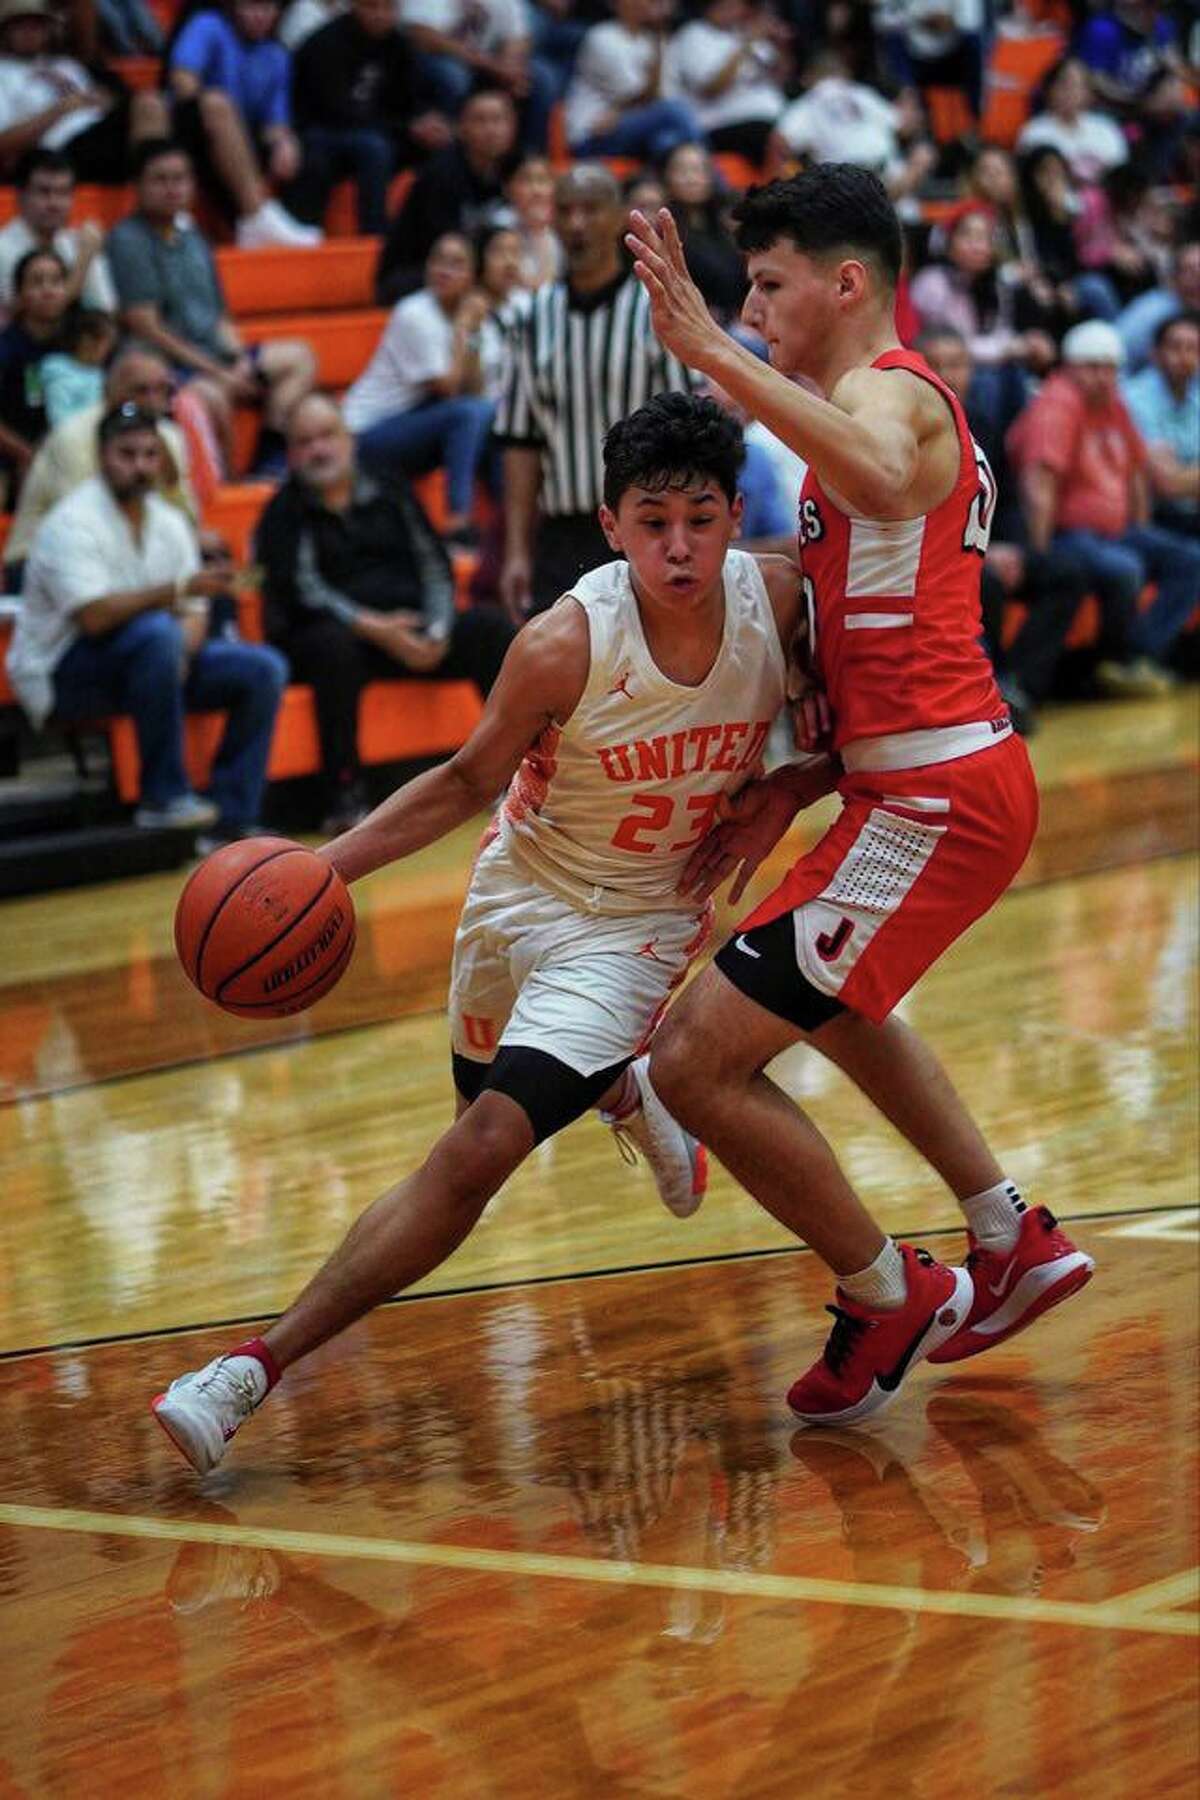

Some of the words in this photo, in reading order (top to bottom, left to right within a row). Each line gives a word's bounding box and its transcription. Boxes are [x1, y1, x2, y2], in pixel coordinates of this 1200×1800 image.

[610, 792, 724, 853] 23
[815, 916, 855, 962] J
[461, 1012, 497, 1051] U
